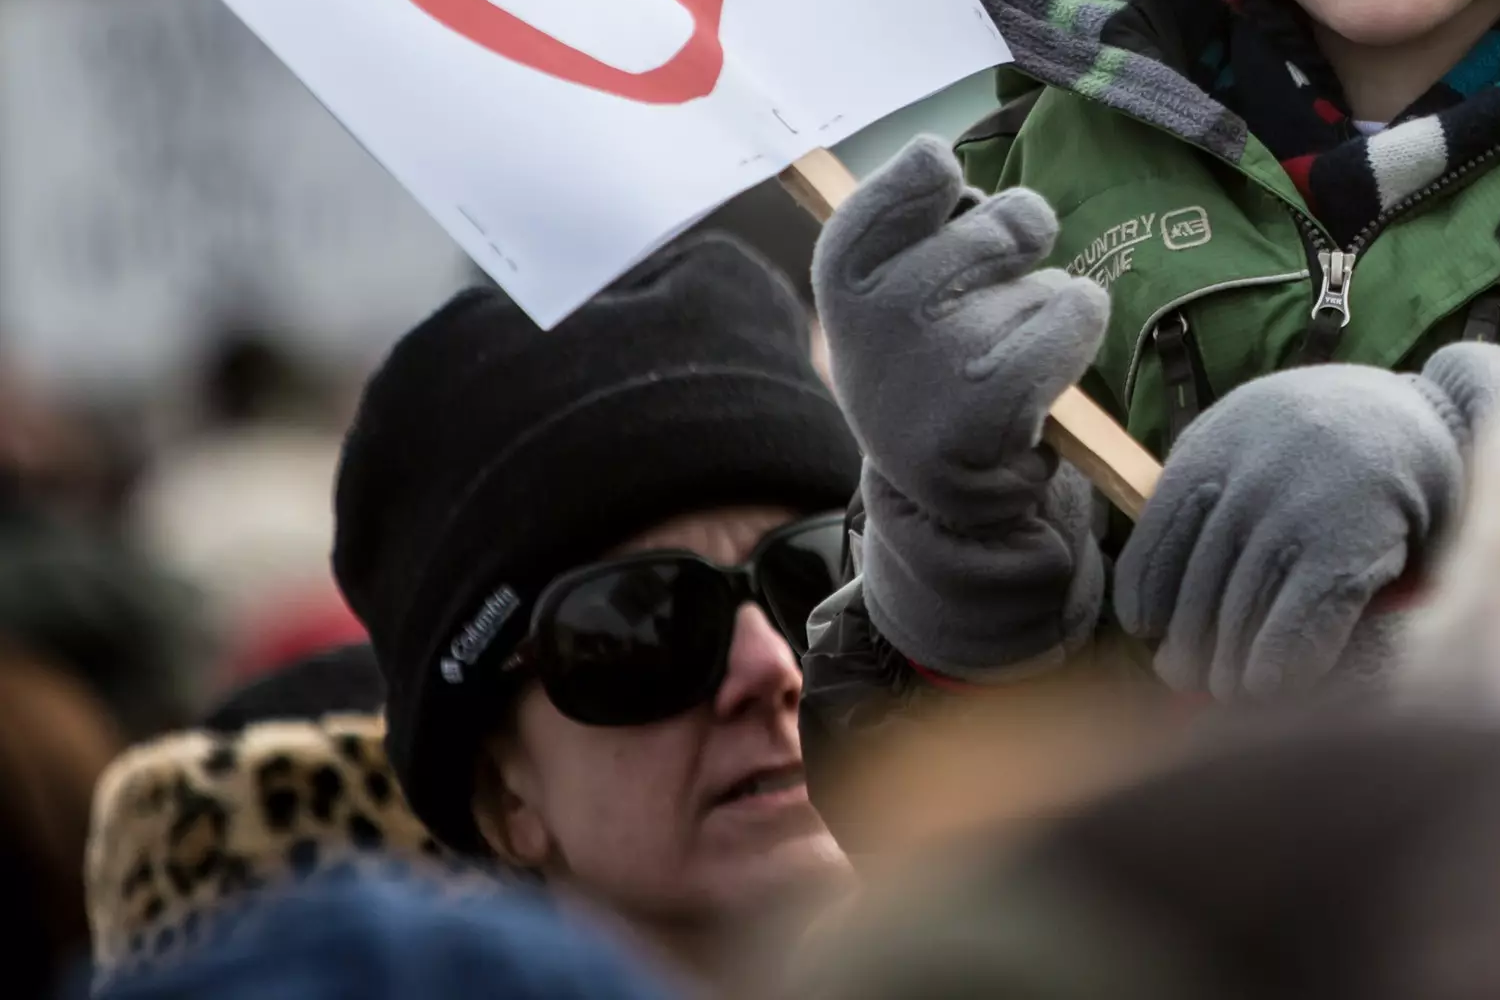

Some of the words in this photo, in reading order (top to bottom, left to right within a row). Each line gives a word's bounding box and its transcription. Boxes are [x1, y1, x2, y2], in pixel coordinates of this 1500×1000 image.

[1065, 212, 1156, 275] COUNTRY
[1325, 296, 1343, 305] YKK
[451, 584, 516, 661] Columbia
